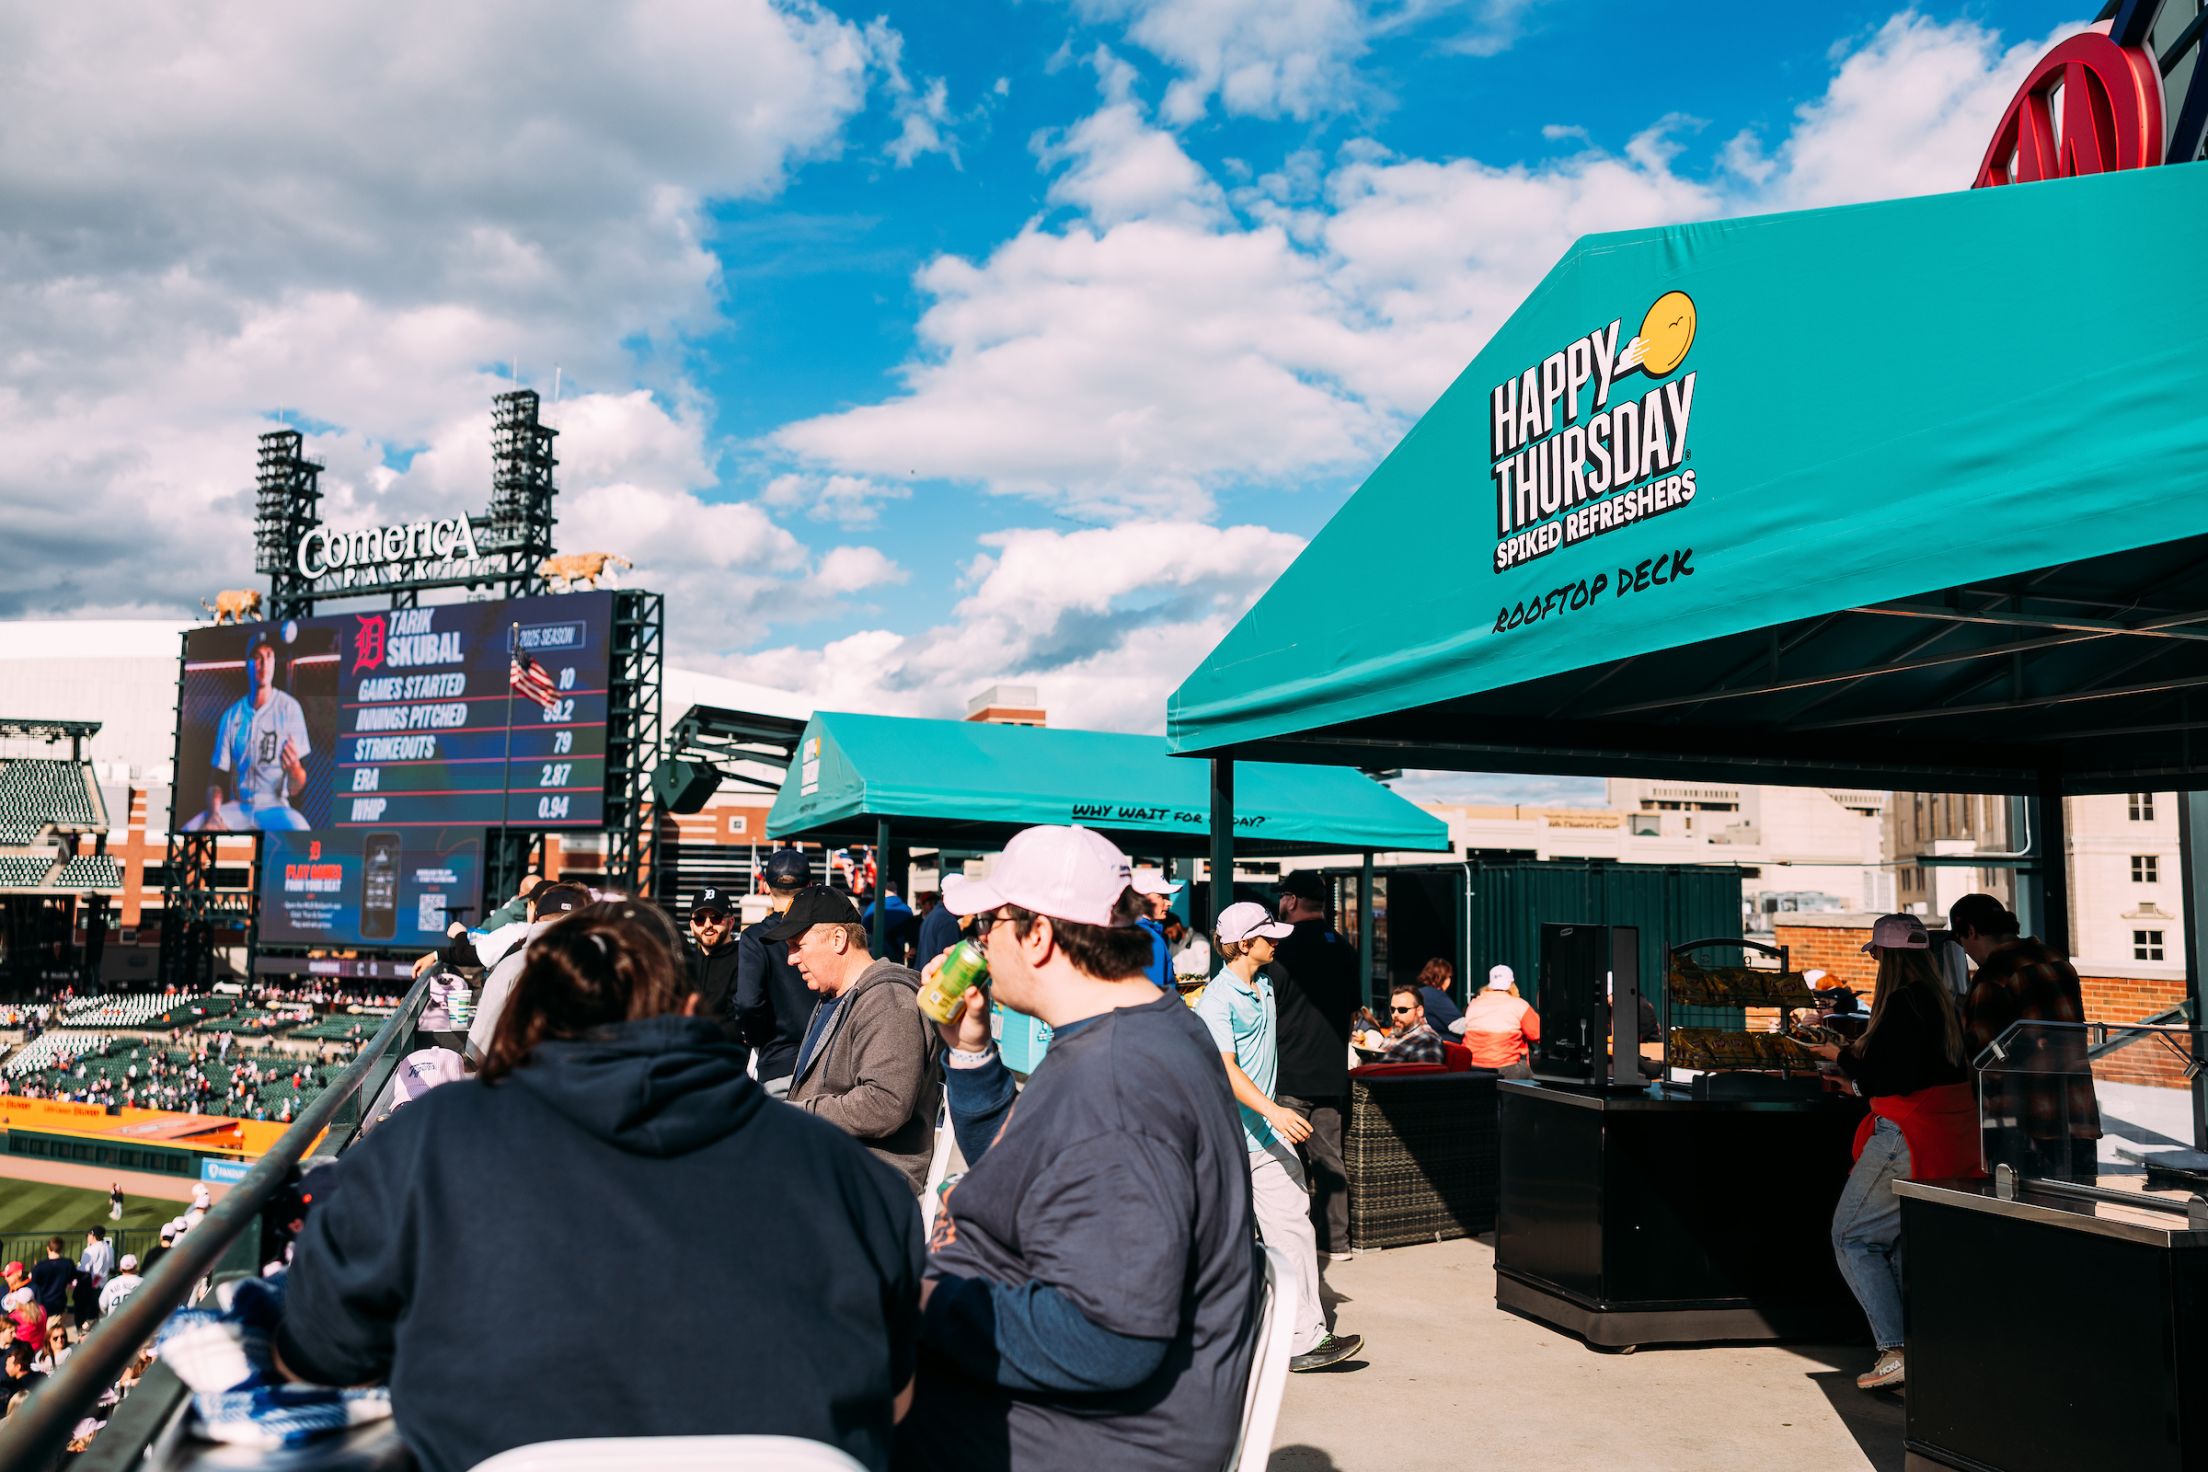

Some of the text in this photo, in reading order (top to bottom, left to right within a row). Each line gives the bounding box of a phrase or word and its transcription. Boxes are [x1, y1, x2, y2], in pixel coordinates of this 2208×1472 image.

[1491, 317, 1621, 458] HAPPY
[1491, 370, 1697, 539] THURSDAY
[1494, 469, 1697, 573] SPIKED REFRESHERS
[343, 560, 429, 588] PARK
[1492, 548, 1695, 634] ROOFTOP DECK
[388, 607, 435, 637] TARIK
[386, 631, 464, 668] SKUBAL
[541, 626, 576, 647] SEASON
[358, 672, 467, 702] GAMES STARTED
[559, 667, 576, 690] 10
[355, 703, 468, 731] INNINGS PITCHED
[354, 735, 437, 761] STRIKEOUTS
[554, 730, 573, 754] 79
[352, 768, 380, 791] ERA
[540, 763, 572, 787] 2.87
[351, 798, 387, 821] WHIP
[538, 796, 570, 819] 0.94
[1072, 803, 1112, 816] WHY
[1119, 806, 1170, 821] WAIT
[1174, 811, 1202, 824] FOR
